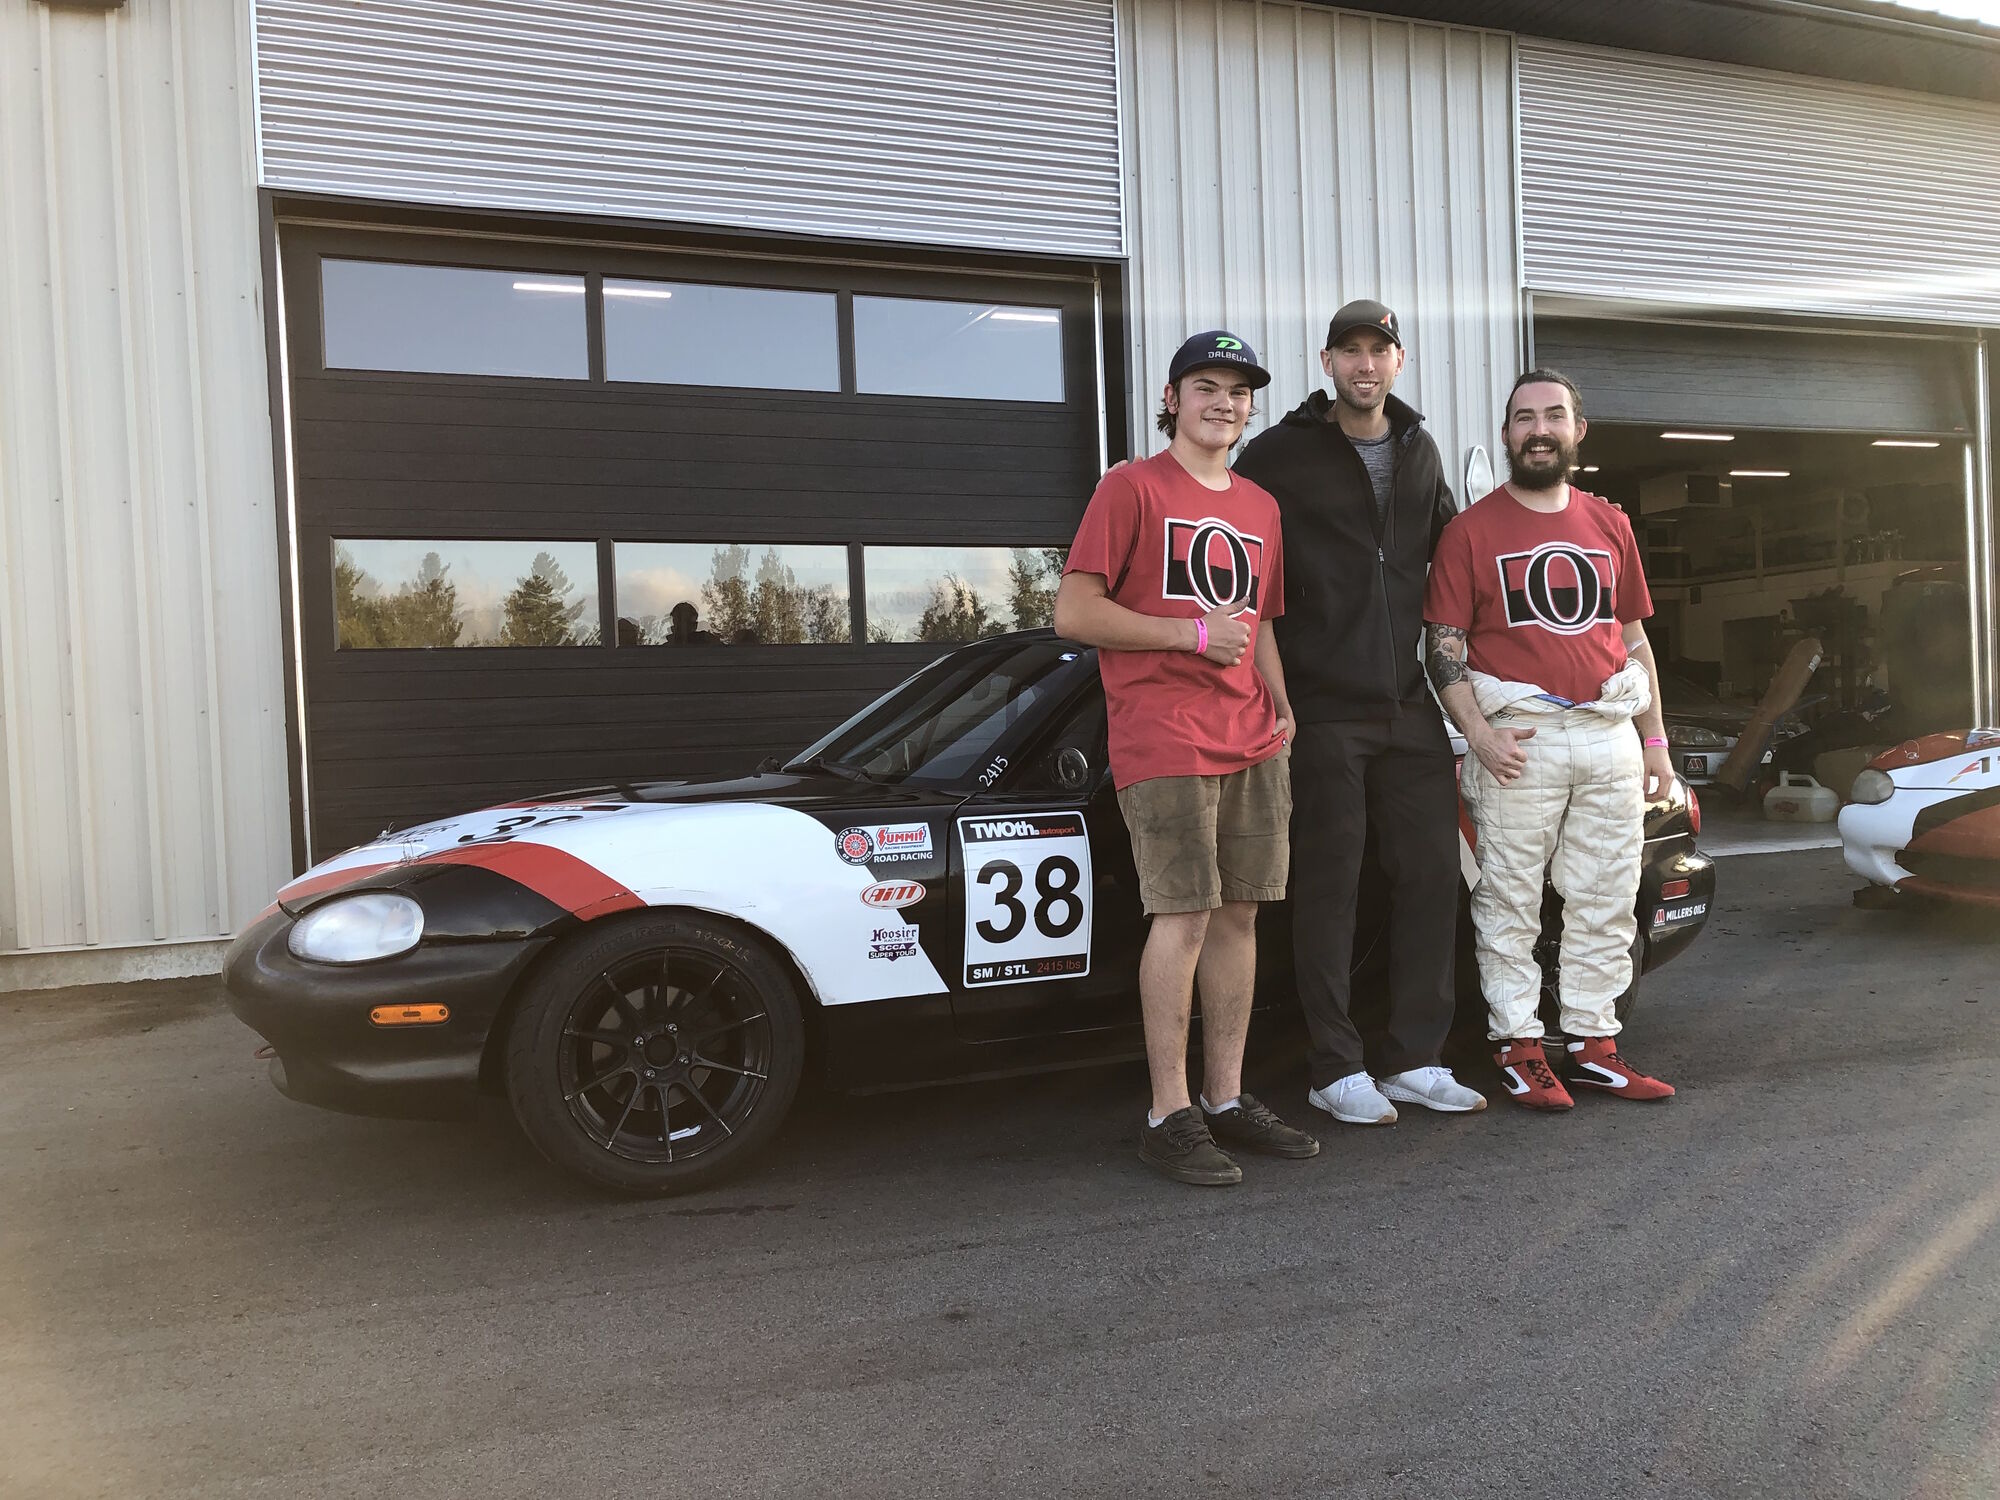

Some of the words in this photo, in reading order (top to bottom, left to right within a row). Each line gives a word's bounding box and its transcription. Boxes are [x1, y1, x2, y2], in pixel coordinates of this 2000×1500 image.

[978, 755, 1009, 787] 2415
[873, 854, 899, 863] ROAD
[900, 852, 934, 862] RACING
[975, 855, 1084, 944] 38
[1666, 906, 1694, 921] MILLERS
[1693, 903, 1706, 915] OILS
[870, 926, 917, 942] Hoosier
[870, 951, 894, 959] SUPER
[895, 948, 916, 957] TOUR
[879, 943, 907, 952] SCCA
[973, 967, 994, 979] SM
[1004, 964, 1030, 976] STL
[1037, 961, 1064, 973] 2415
[1066, 960, 1081, 970] lbs
